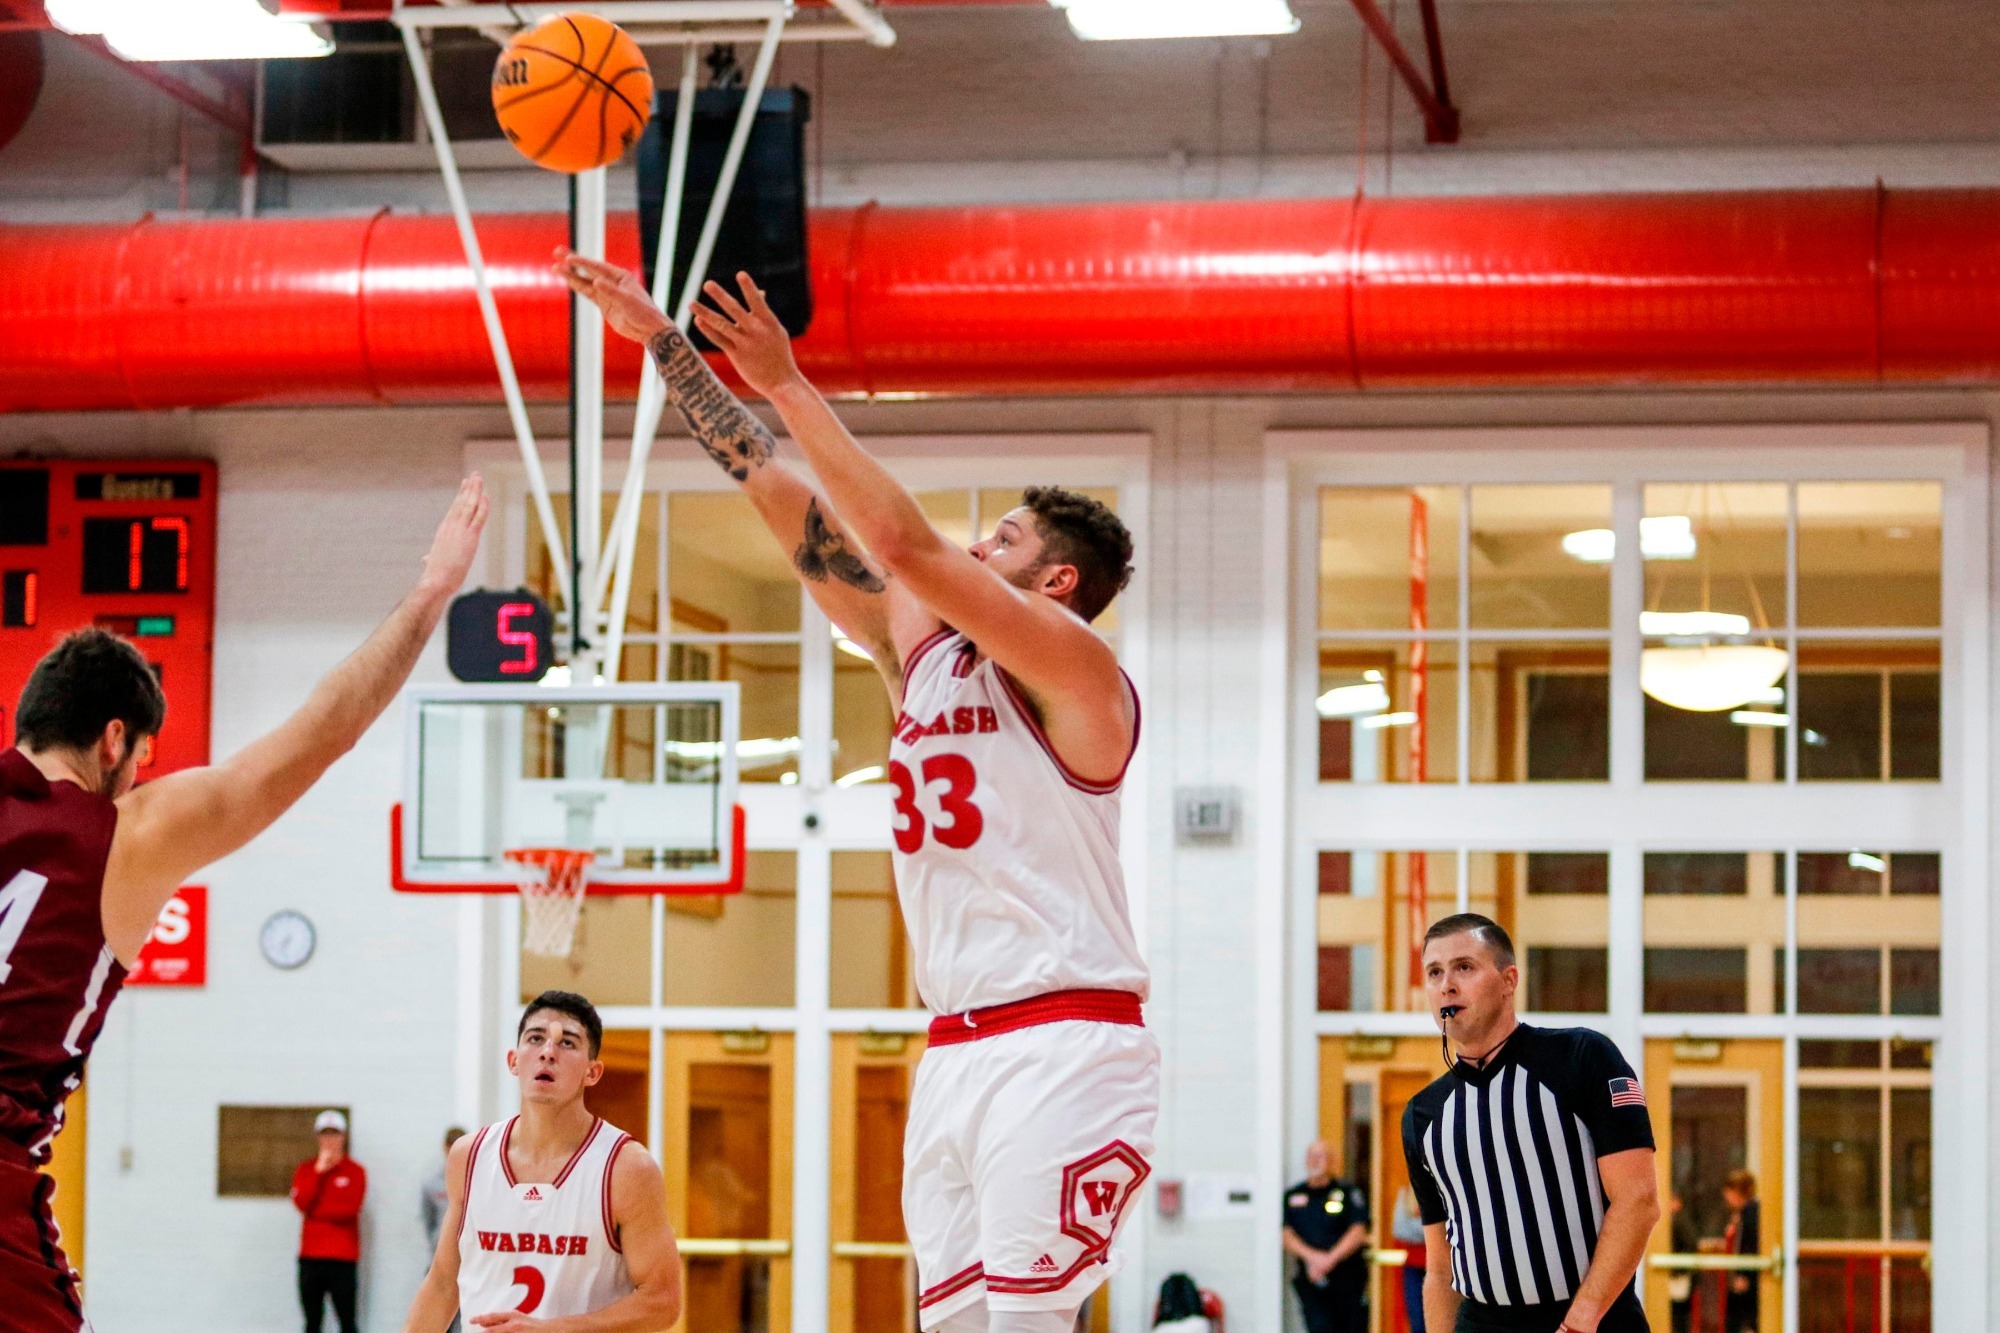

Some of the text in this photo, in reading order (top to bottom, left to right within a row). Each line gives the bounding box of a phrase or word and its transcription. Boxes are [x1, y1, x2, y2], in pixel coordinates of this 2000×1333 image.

[129, 516, 188, 590] 17
[497, 603, 537, 673] 5
[889, 753, 984, 855] 33
[477, 1231, 588, 1256] WABASH
